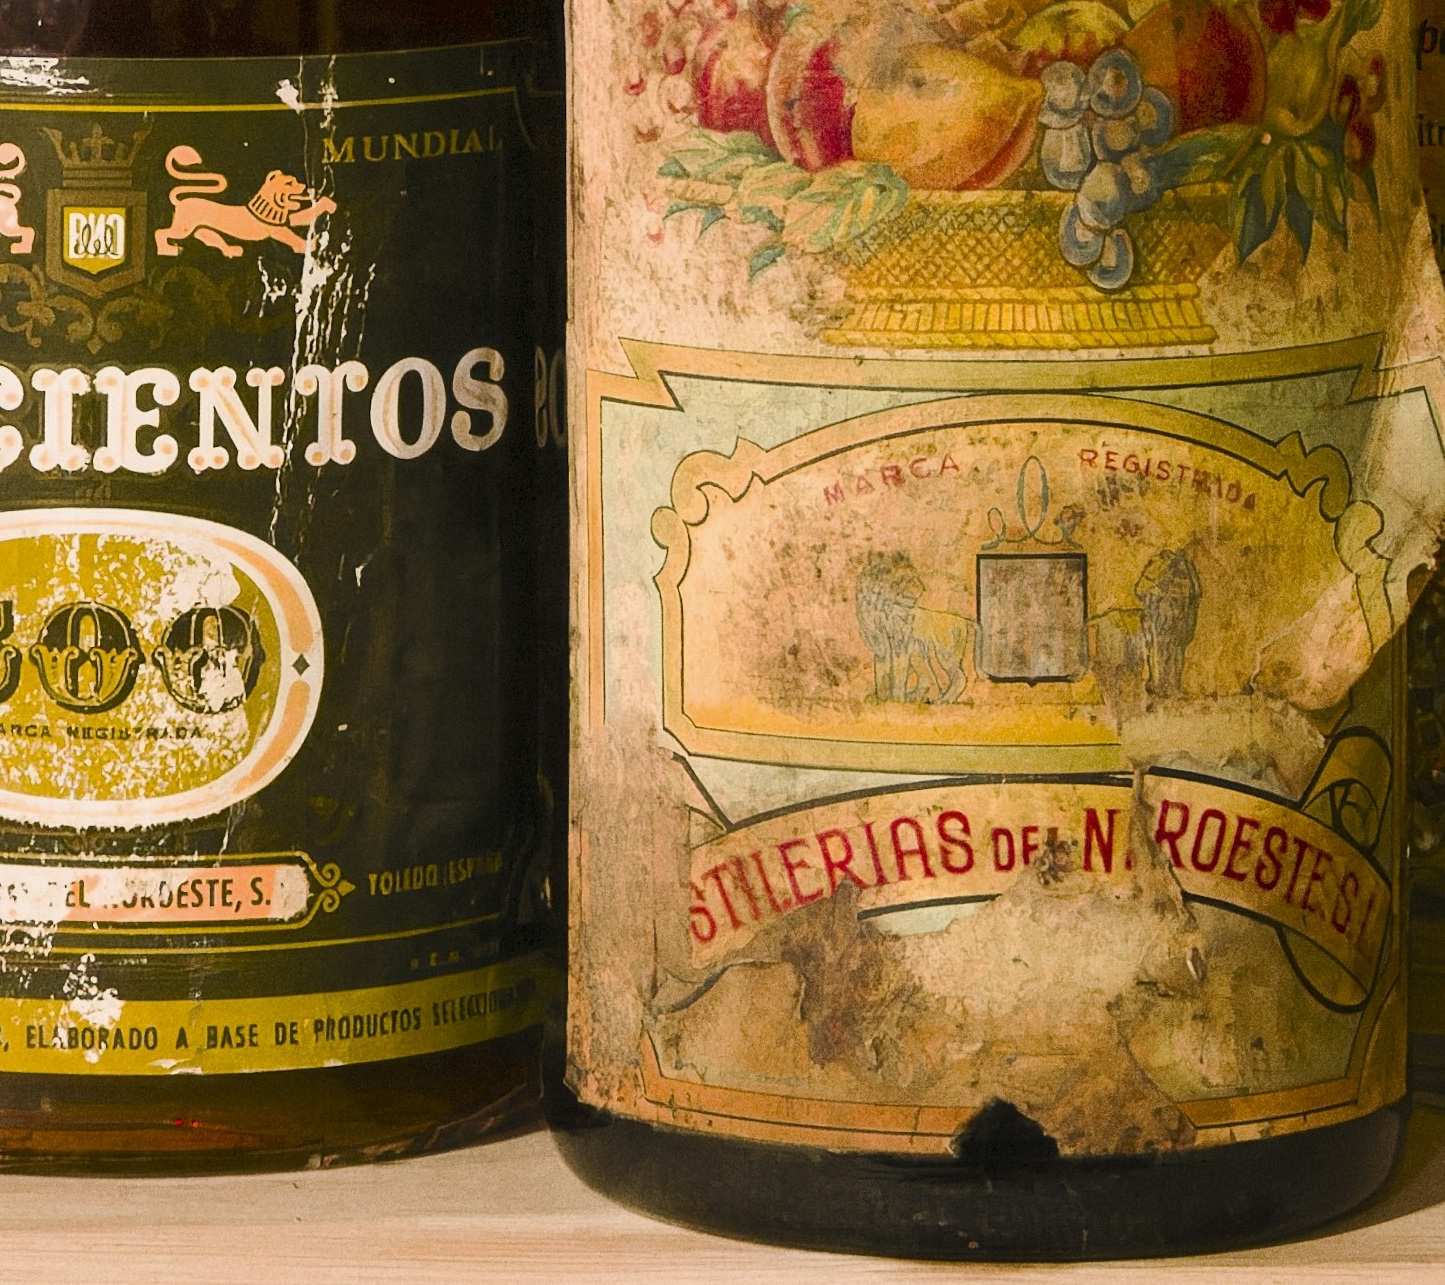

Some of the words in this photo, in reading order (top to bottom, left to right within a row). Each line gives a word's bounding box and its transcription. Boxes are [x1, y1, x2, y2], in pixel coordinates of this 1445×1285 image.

[320, 124, 505, 166] MUNDIAL
[821, 452, 961, 507] MARCA
[687, 809, 976, 945] STILERIAS
[1082, 799, 1334, 916] NROESTE
[25, 1024, 160, 1051] ELABORADO
[174, 1025, 190, 1050] A
[205, 1022, 261, 1050] BASE
[274, 1020, 301, 1047] DE
[312, 1005, 422, 1044] PRODUCTOS
